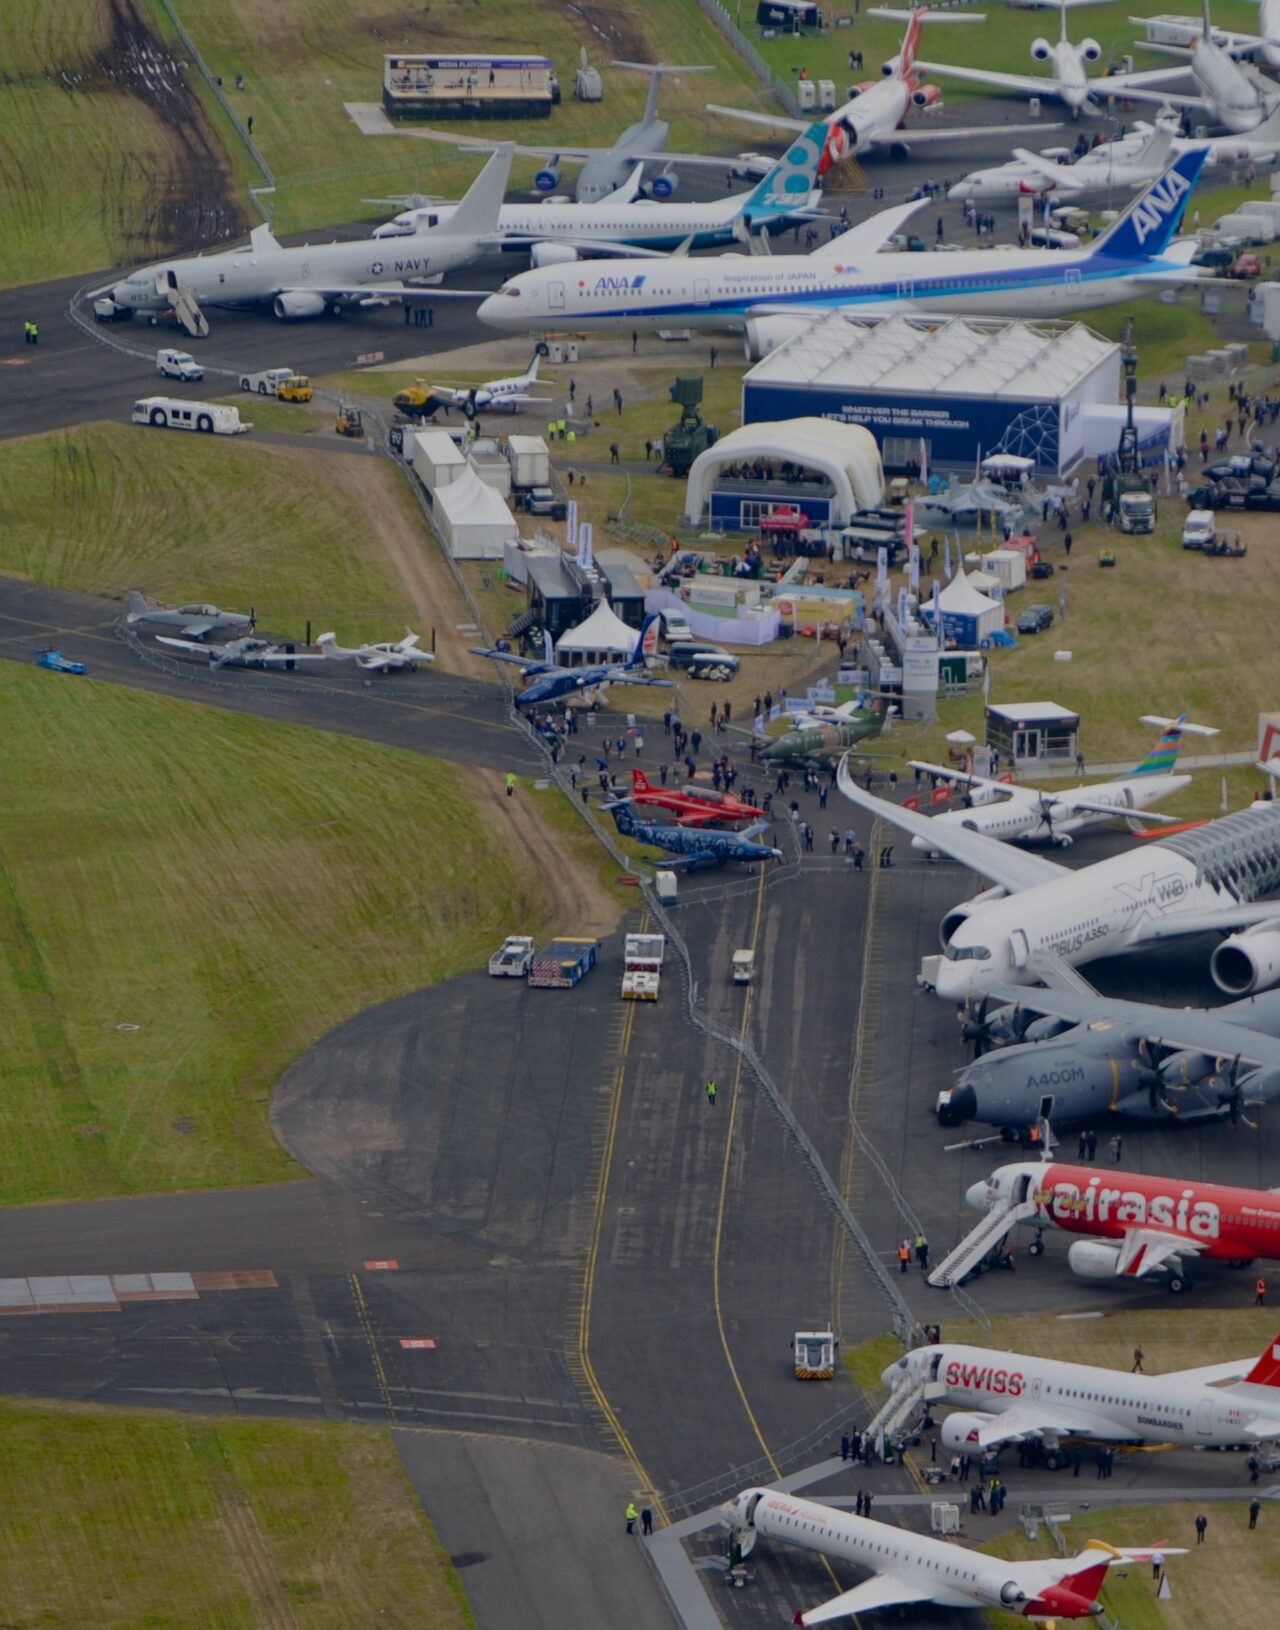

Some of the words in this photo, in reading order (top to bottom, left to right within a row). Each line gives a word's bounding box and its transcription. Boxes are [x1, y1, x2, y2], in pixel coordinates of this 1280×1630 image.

[1131, 168, 1192, 245] ANA
[395, 258, 430, 272] NAVY
[594, 277, 630, 290] ANA
[724, 273, 774, 283] Inspiration
[775, 273, 784, 281] of
[786, 272, 817, 281] JAPAN
[841, 405, 891, 416] WHATEVER
[891, 408, 909, 417] THE
[910, 409, 950, 419] BARRIER
[847, 413, 872, 423] HELP
[872, 415, 892, 424] YOU
[892, 416, 924, 426] BREAK
[925, 417, 970, 428] THROUGH
[1084, 924, 1109, 944] A350
[1026, 1067, 1085, 1089] A400M
[1053, 1176, 1220, 1240] airasia
[1241, 1206, 1257, 1215] Now
[945, 1361, 1024, 1397] SWISS
[1137, 1415, 1184, 1431] BOMBARDIER
